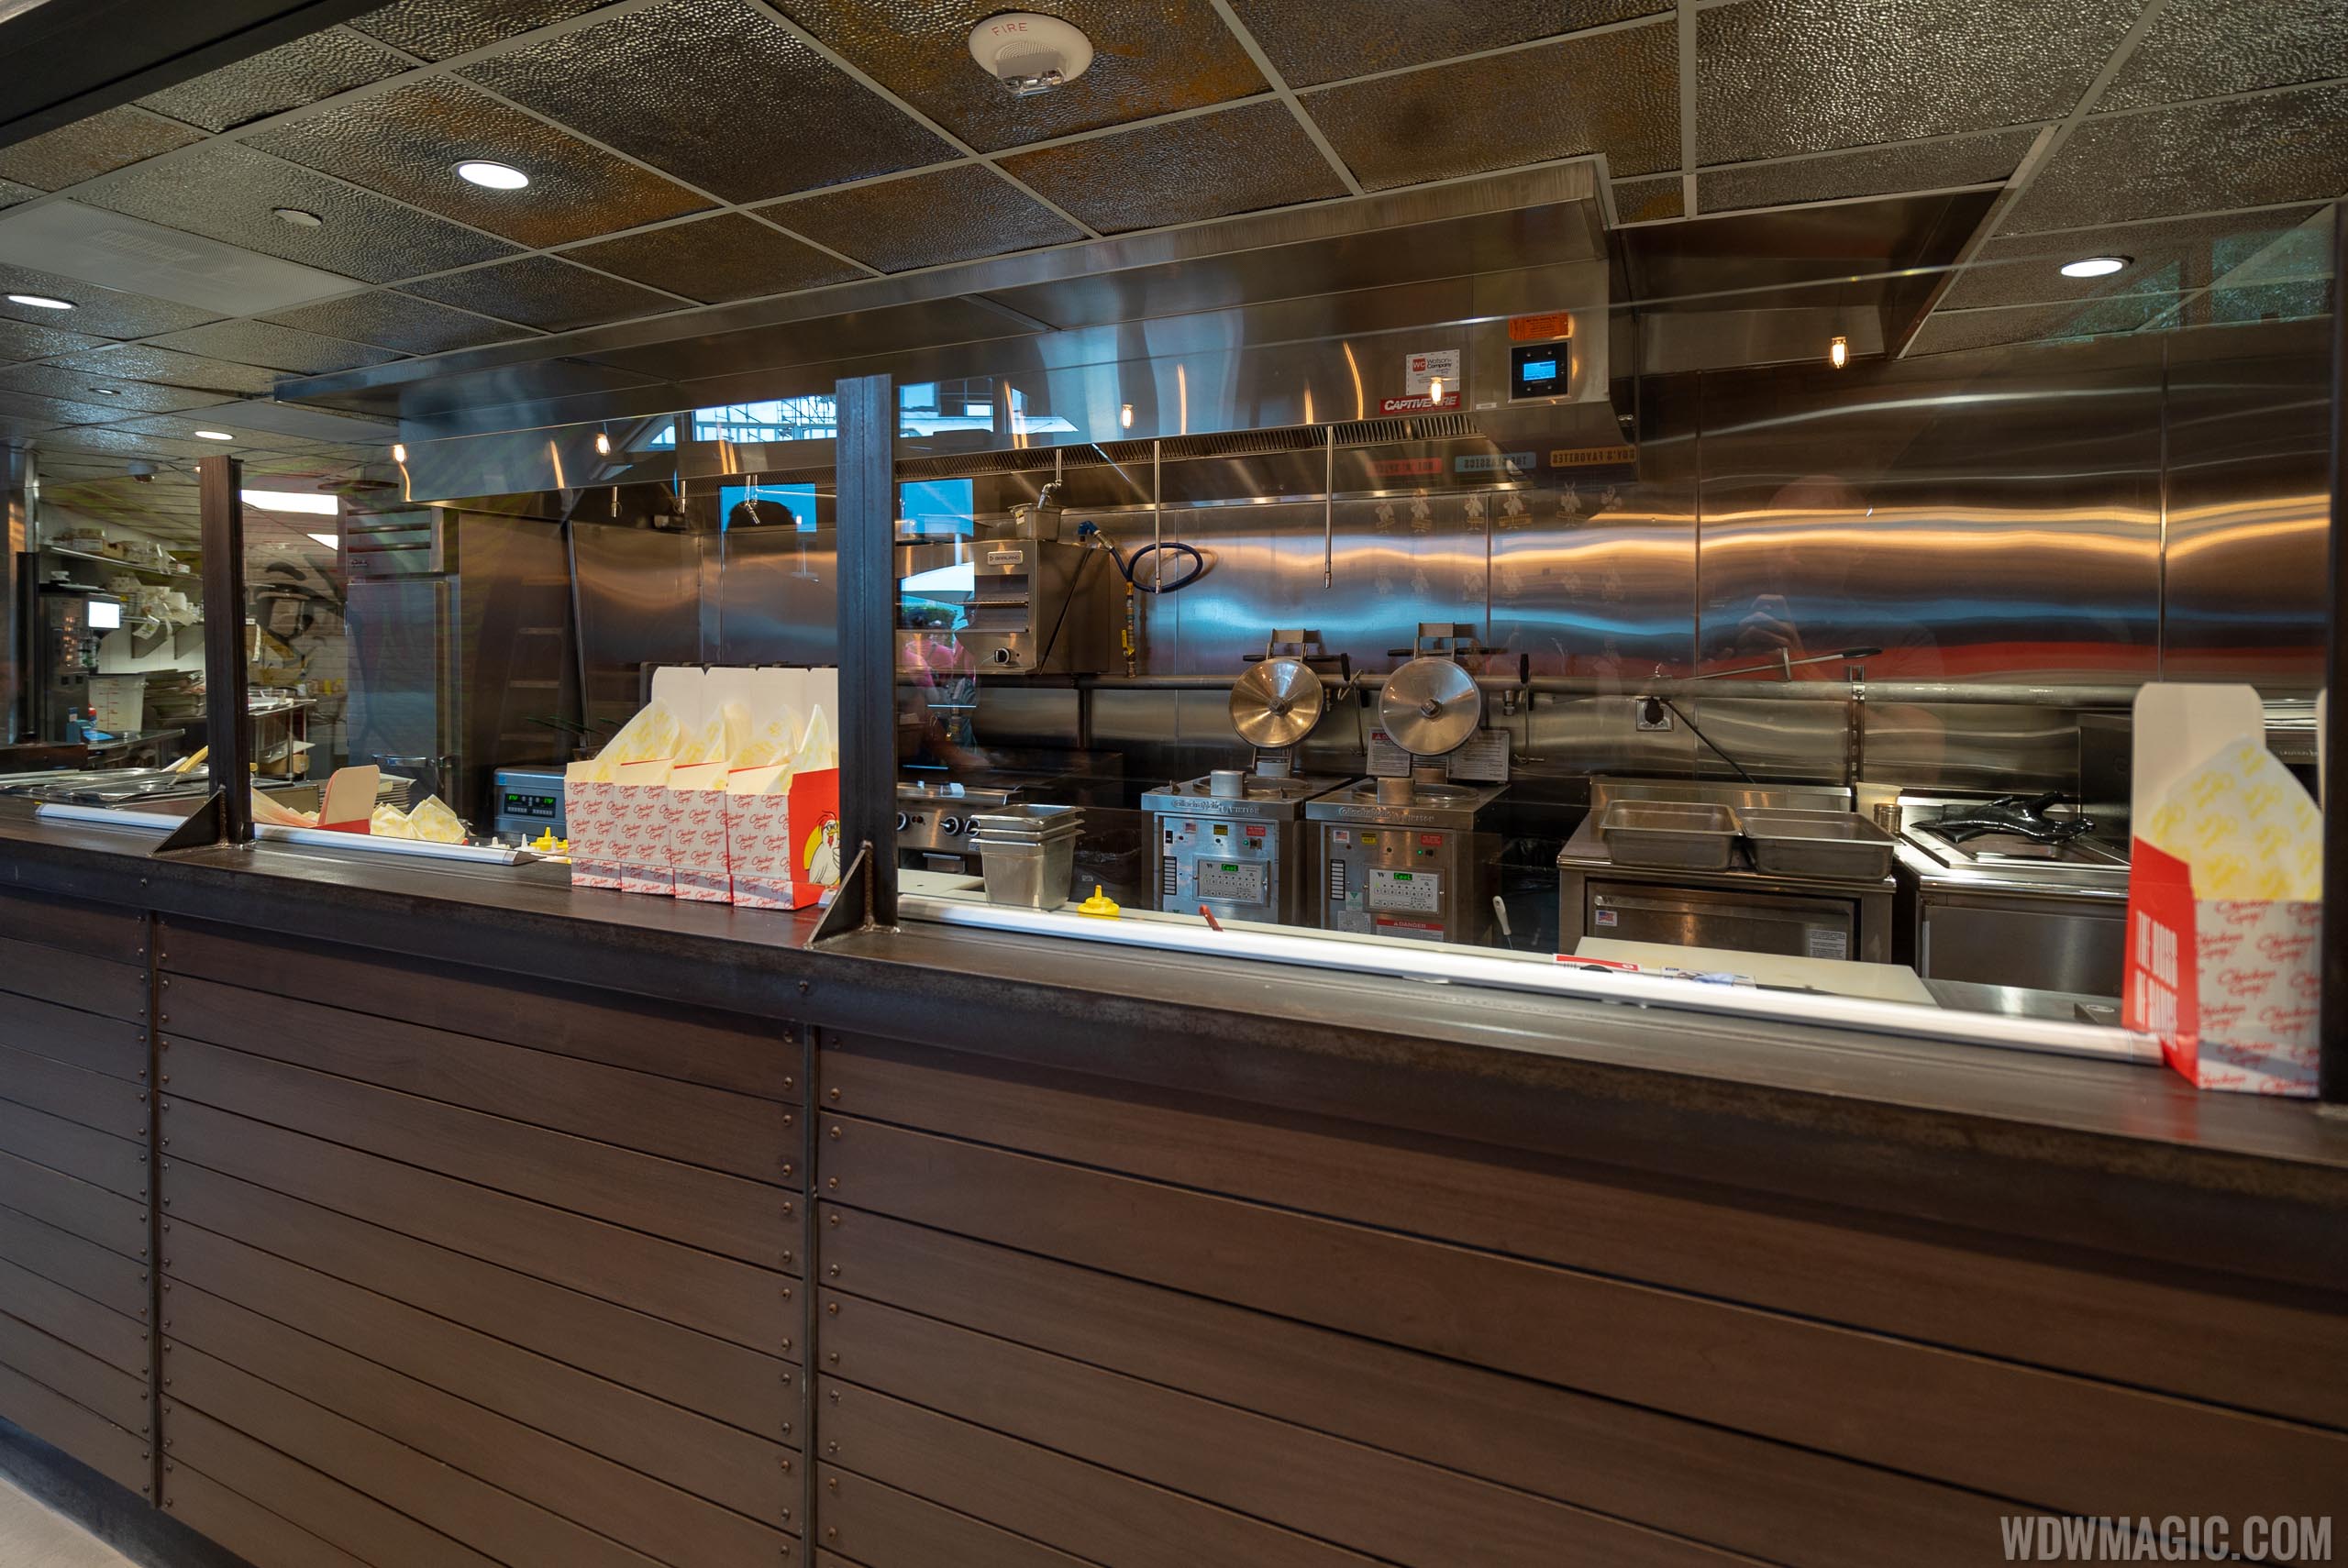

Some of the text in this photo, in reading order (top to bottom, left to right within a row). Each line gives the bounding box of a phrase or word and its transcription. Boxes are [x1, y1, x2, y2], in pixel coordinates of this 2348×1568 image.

[991, 22, 1028, 36] FIRE
[583, 801, 603, 809] Chicken
[633, 805, 654, 813] Chicken
[689, 810, 711, 819] Chicken
[749, 814, 773, 823] Chicken
[572, 820, 590, 828] Chicken
[594, 821, 615, 829] Chicken
[646, 825, 667, 834] Chicken
[676, 830, 697, 838] Chicken
[701, 830, 725, 839] Chicken
[736, 834, 758, 844] Chicken
[585, 839, 604, 848] Chicken
[763, 835, 787, 845] Chicken
[636, 845, 657, 853] Chicken
[691, 851, 712, 859] Chicken
[752, 856, 775, 866] Chicken
[626, 863, 646, 871] Chicken
[680, 870, 700, 878] Chicken
[704, 872, 725, 880] Chicken
[591, 878, 608, 887] Chicken
[740, 877, 761, 885] Chicken
[641, 884, 660, 893] Chicken
[696, 890, 716, 900] Chicken
[757, 897, 779, 907] Chicken
